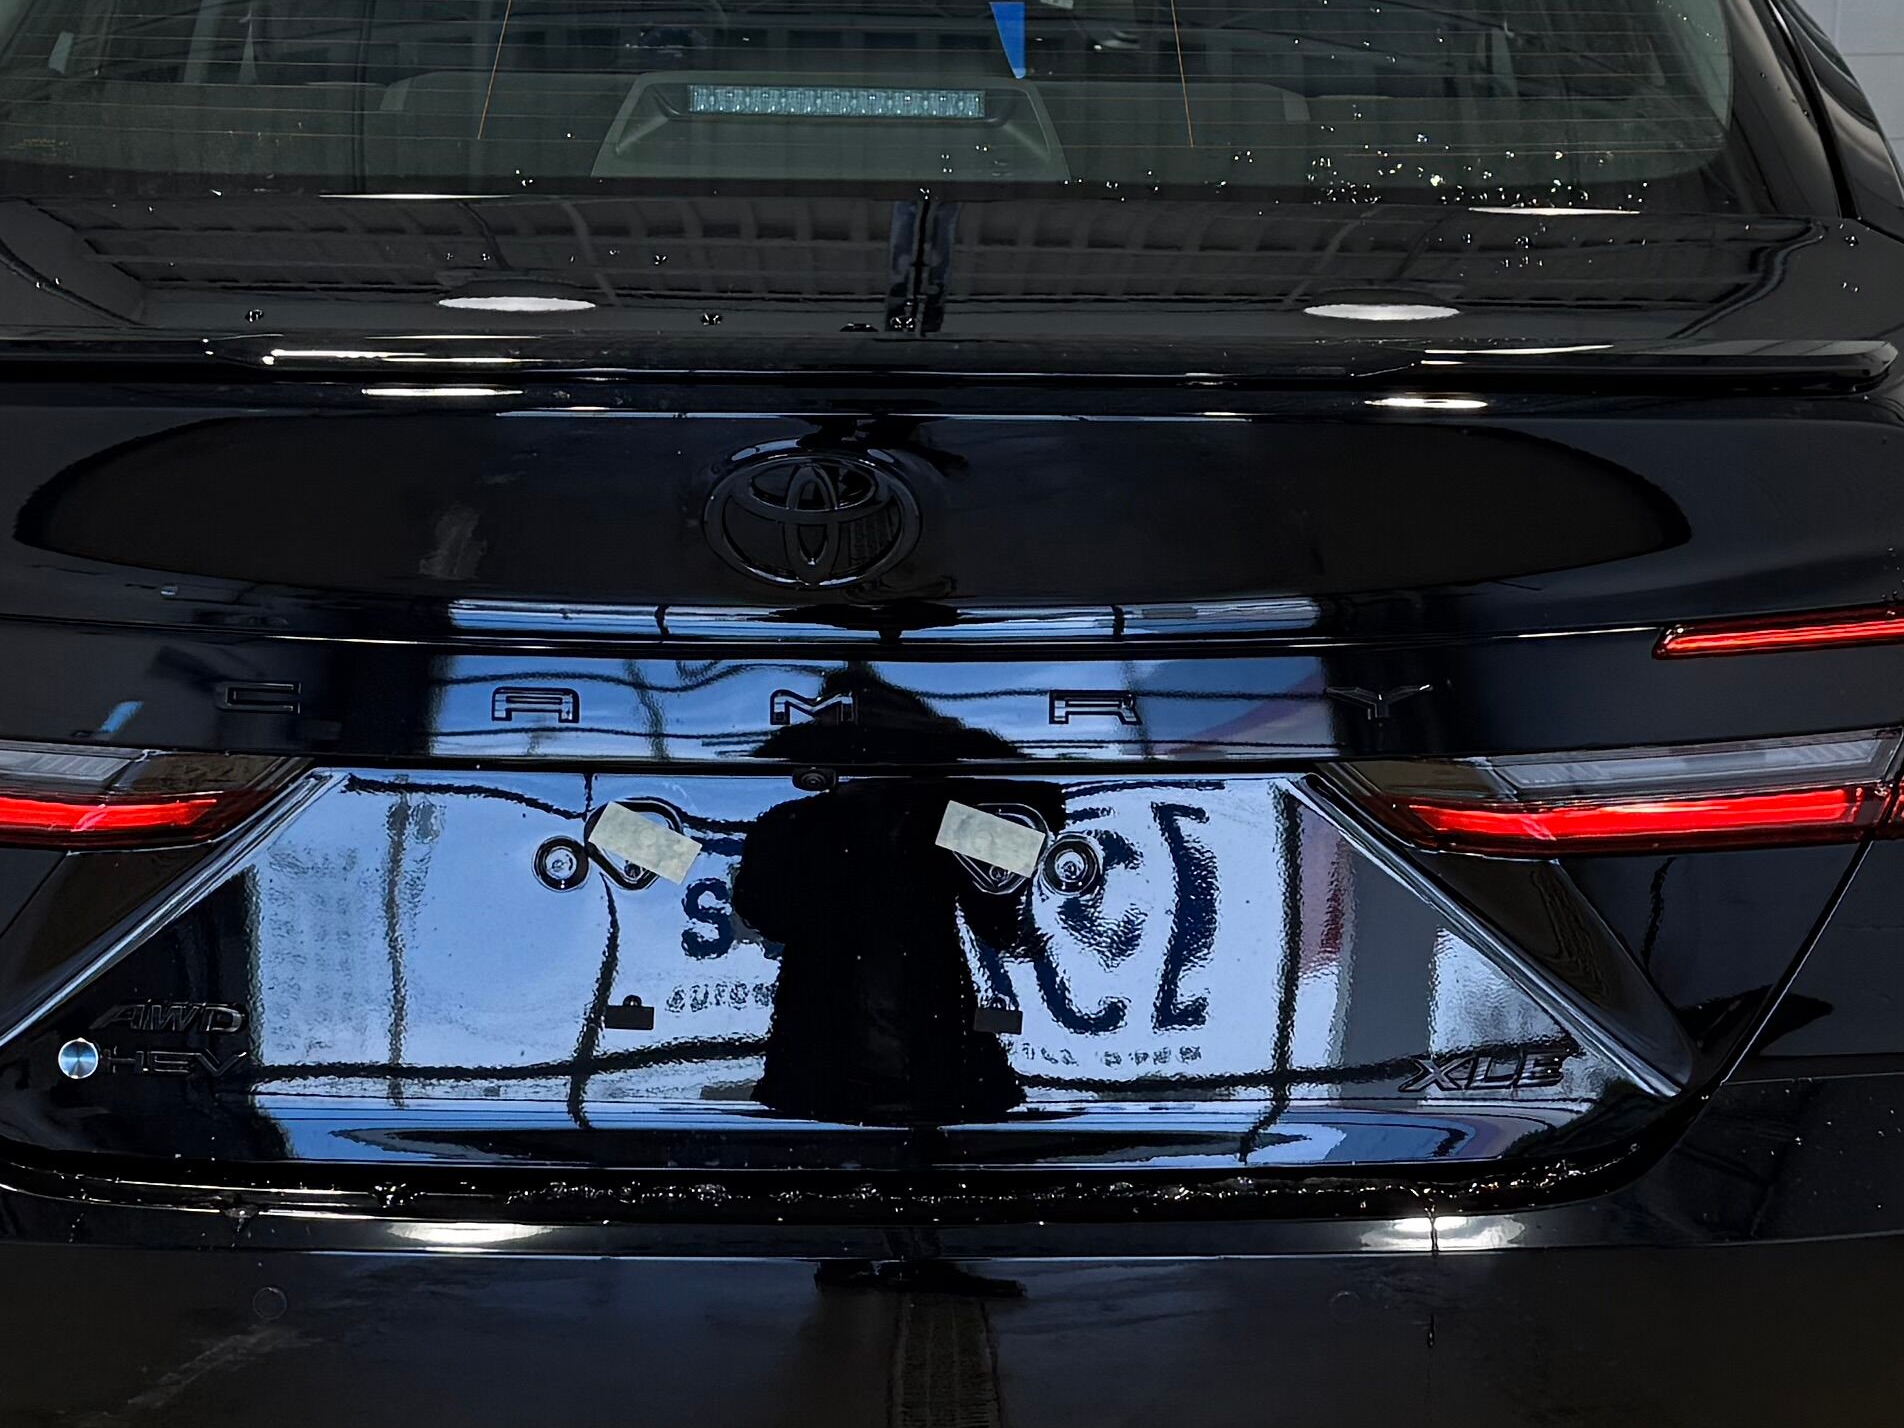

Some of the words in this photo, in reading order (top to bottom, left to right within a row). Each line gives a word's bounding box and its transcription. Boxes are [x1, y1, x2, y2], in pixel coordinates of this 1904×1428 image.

[216, 680, 1433, 726] CAMRY
[87, 1000, 245, 1033] AWD
[99, 1045, 247, 1078] HEV
[1398, 1049, 1564, 1093] XLE
